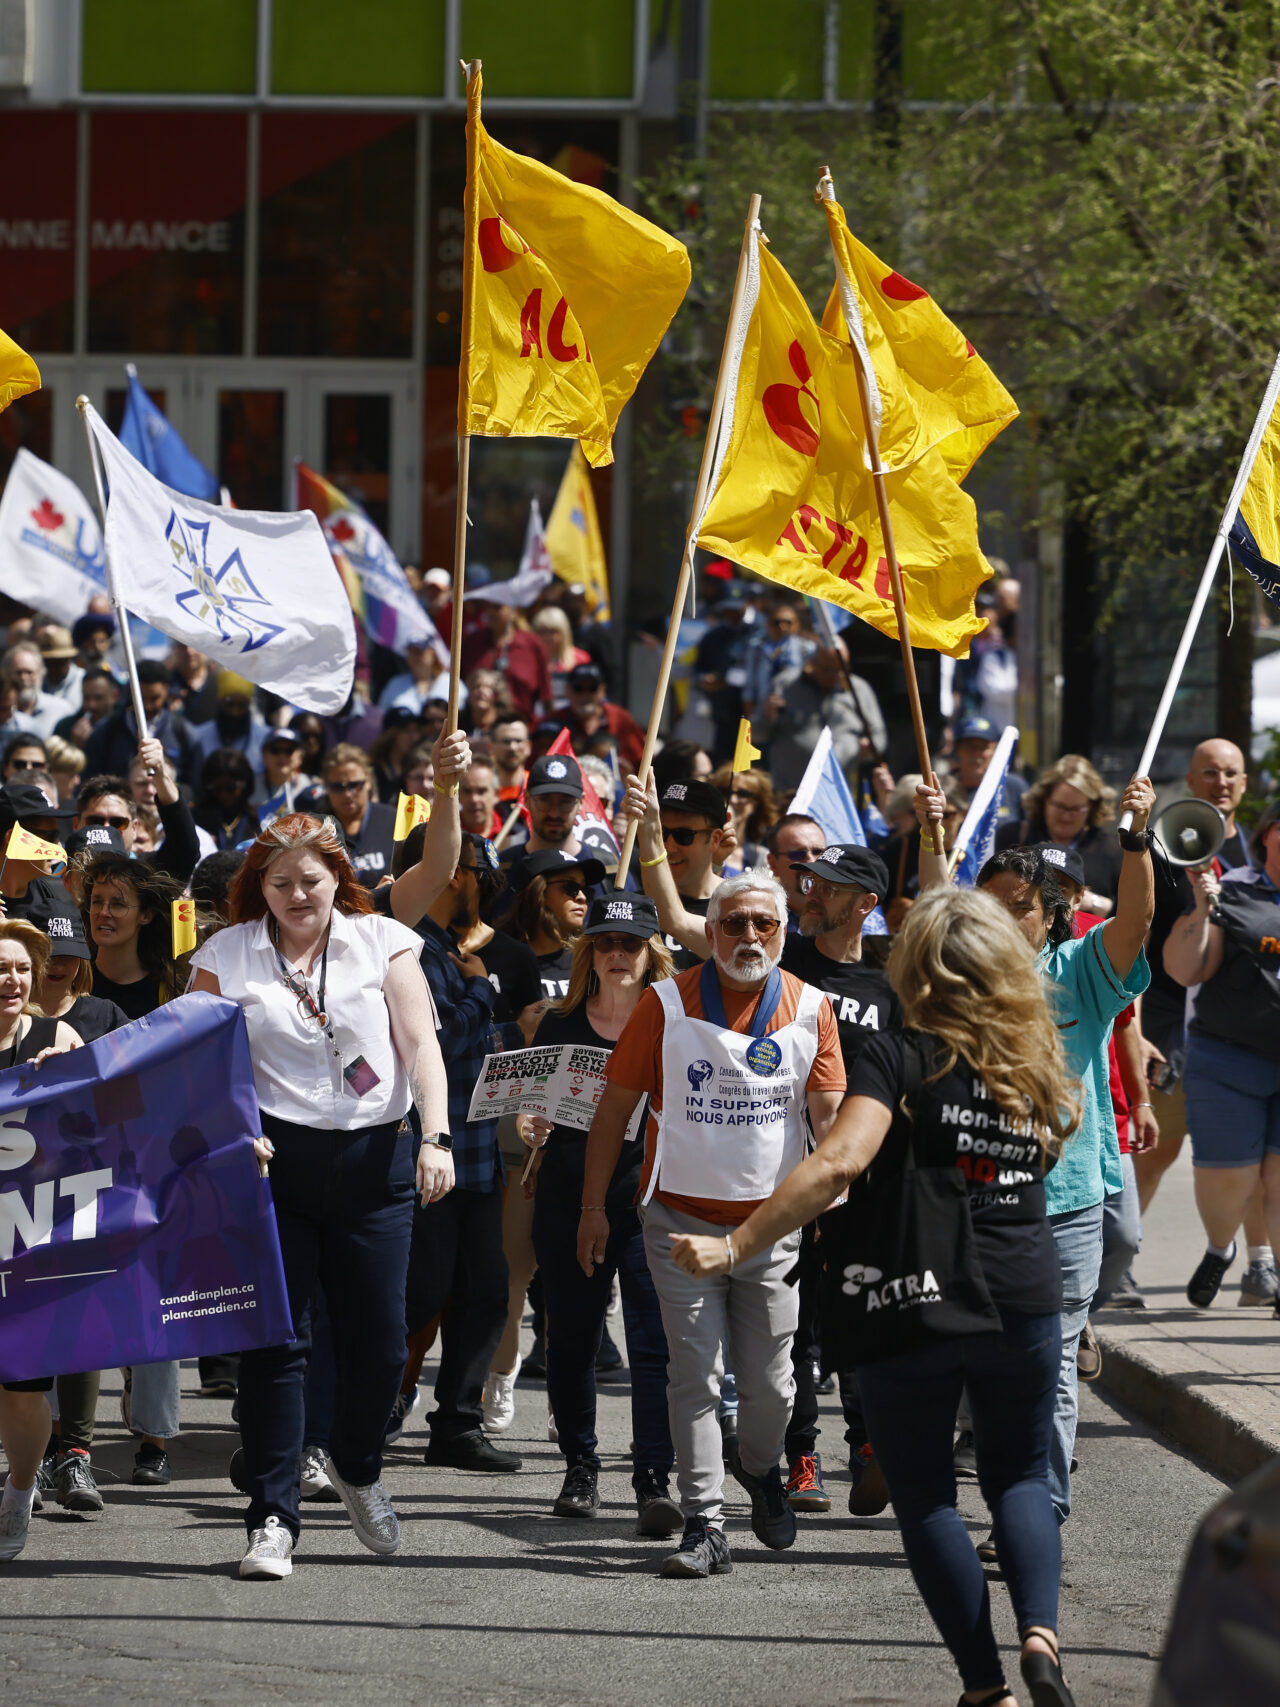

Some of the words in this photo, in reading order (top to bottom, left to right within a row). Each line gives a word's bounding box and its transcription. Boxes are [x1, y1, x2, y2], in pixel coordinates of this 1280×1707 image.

[91, 220, 231, 252] MANCE
[607, 907, 632, 915] TAKES
[608, 901, 633, 909] ACTRA
[48, 917, 72, 926] ACTRA
[605, 913, 633, 921] ACTION
[48, 923, 72, 932] TAKES
[489, 1051, 533, 1063] SOLIDARITY
[572, 1048, 605, 1059] SOYONS
[488, 1054, 562, 1071] BOYCOTT
[568, 1060, 589, 1071] CES
[570, 1054, 606, 1067] BOYC
[484, 1067, 557, 1084] BRANDS
[743, 1086, 750, 1096] du
[522, 1103, 547, 1113] ACTRA
[686, 1096, 703, 1107] IN
[710, 1097, 792, 1111] SUPPORT
[686, 1110, 723, 1124] NOUS
[727, 1108, 788, 1126] APPUYONS
[956, 1131, 1038, 1163] Doesn't
[160, 1281, 256, 1307] canadianplan.ca
[866, 1269, 940, 1313] ACTRA
[161, 1297, 258, 1324] plancanadien.ca
